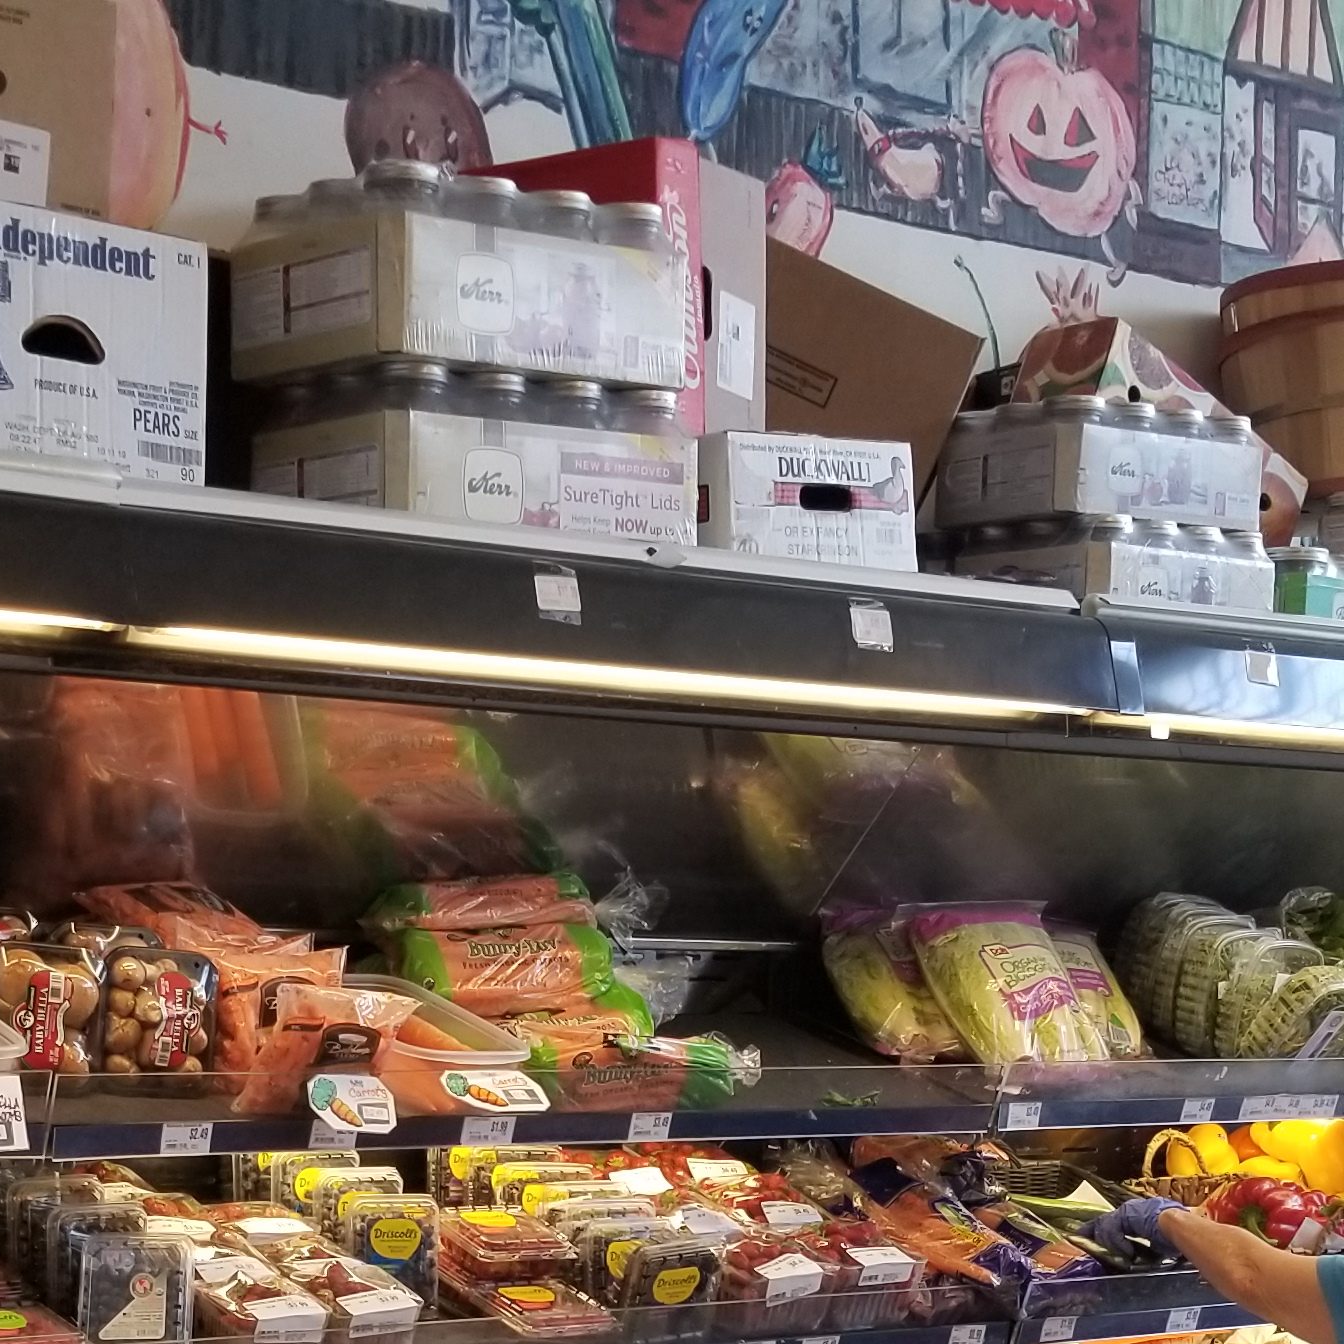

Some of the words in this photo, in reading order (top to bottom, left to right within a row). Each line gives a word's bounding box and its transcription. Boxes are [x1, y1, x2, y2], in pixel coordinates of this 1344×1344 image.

[177, 252, 195, 268] CAT.
[459, 277, 503, 304] Kerr
[34, 379, 66, 394] PRODUCE
[69, 384, 79, 396] OF
[133, 407, 181, 438] PEARS
[184, 429, 199, 441] SIZE
[180, 467, 195, 482] 90
[575, 458, 599, 472] NEW
[604, 461, 610, 472] &
[614, 462, 670, 479] IMPROVED
[1111, 462, 1135, 478] Kerr
[467, 470, 512, 497] Kerr
[564, 485, 640, 511] SureTight
[651, 492, 681, 511] Lids
[614, 516, 648, 534] NOW
[649, 527, 662, 539] up
[38, 987, 49, 1023] BELLA
[35, 1024, 45, 1053] BABY
[171, 1018, 182, 1052] BELLA
[189, 1127, 208, 1140] $2.49
[373, 1228, 418, 1240] Driscoll's
[656, 1273, 698, 1288] Driscoll's
